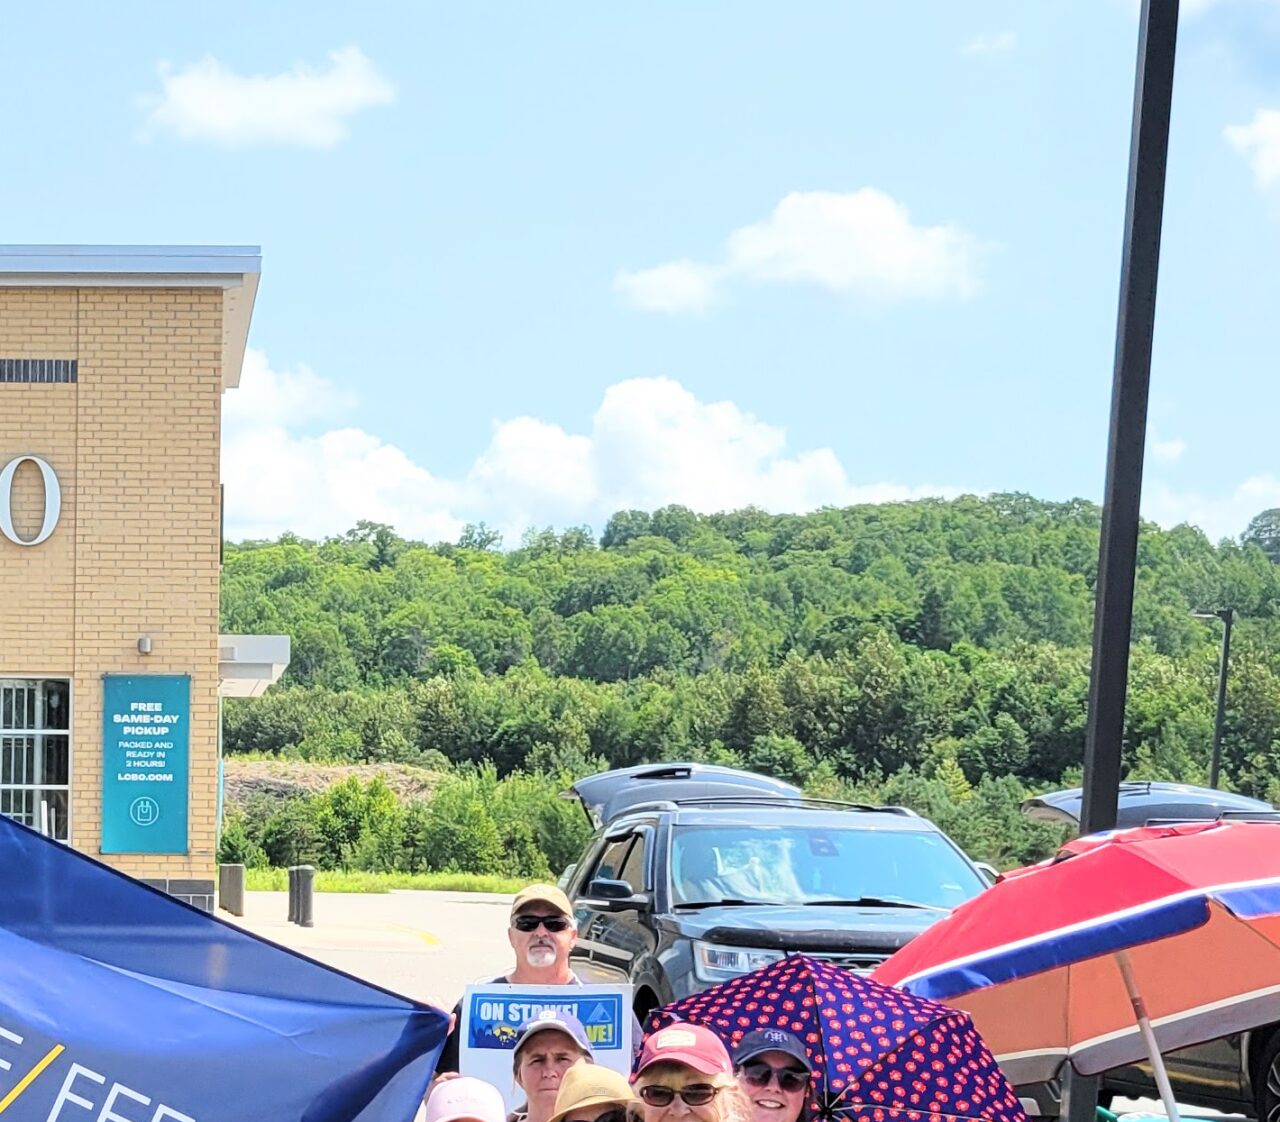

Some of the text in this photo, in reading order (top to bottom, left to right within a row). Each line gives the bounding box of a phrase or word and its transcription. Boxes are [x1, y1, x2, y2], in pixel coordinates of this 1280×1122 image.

[130, 702, 162, 712] FREE
[113, 714, 180, 724] SAME-DAY
[123, 726, 169, 736] PICKUP
[118, 741, 173, 750] PACKED AND
[126, 751, 166, 759] READY IN
[126, 760, 166, 768] 2 HOURS!
[118, 773, 173, 782] LCBO.COM
[480, 1002, 504, 1021] ON
